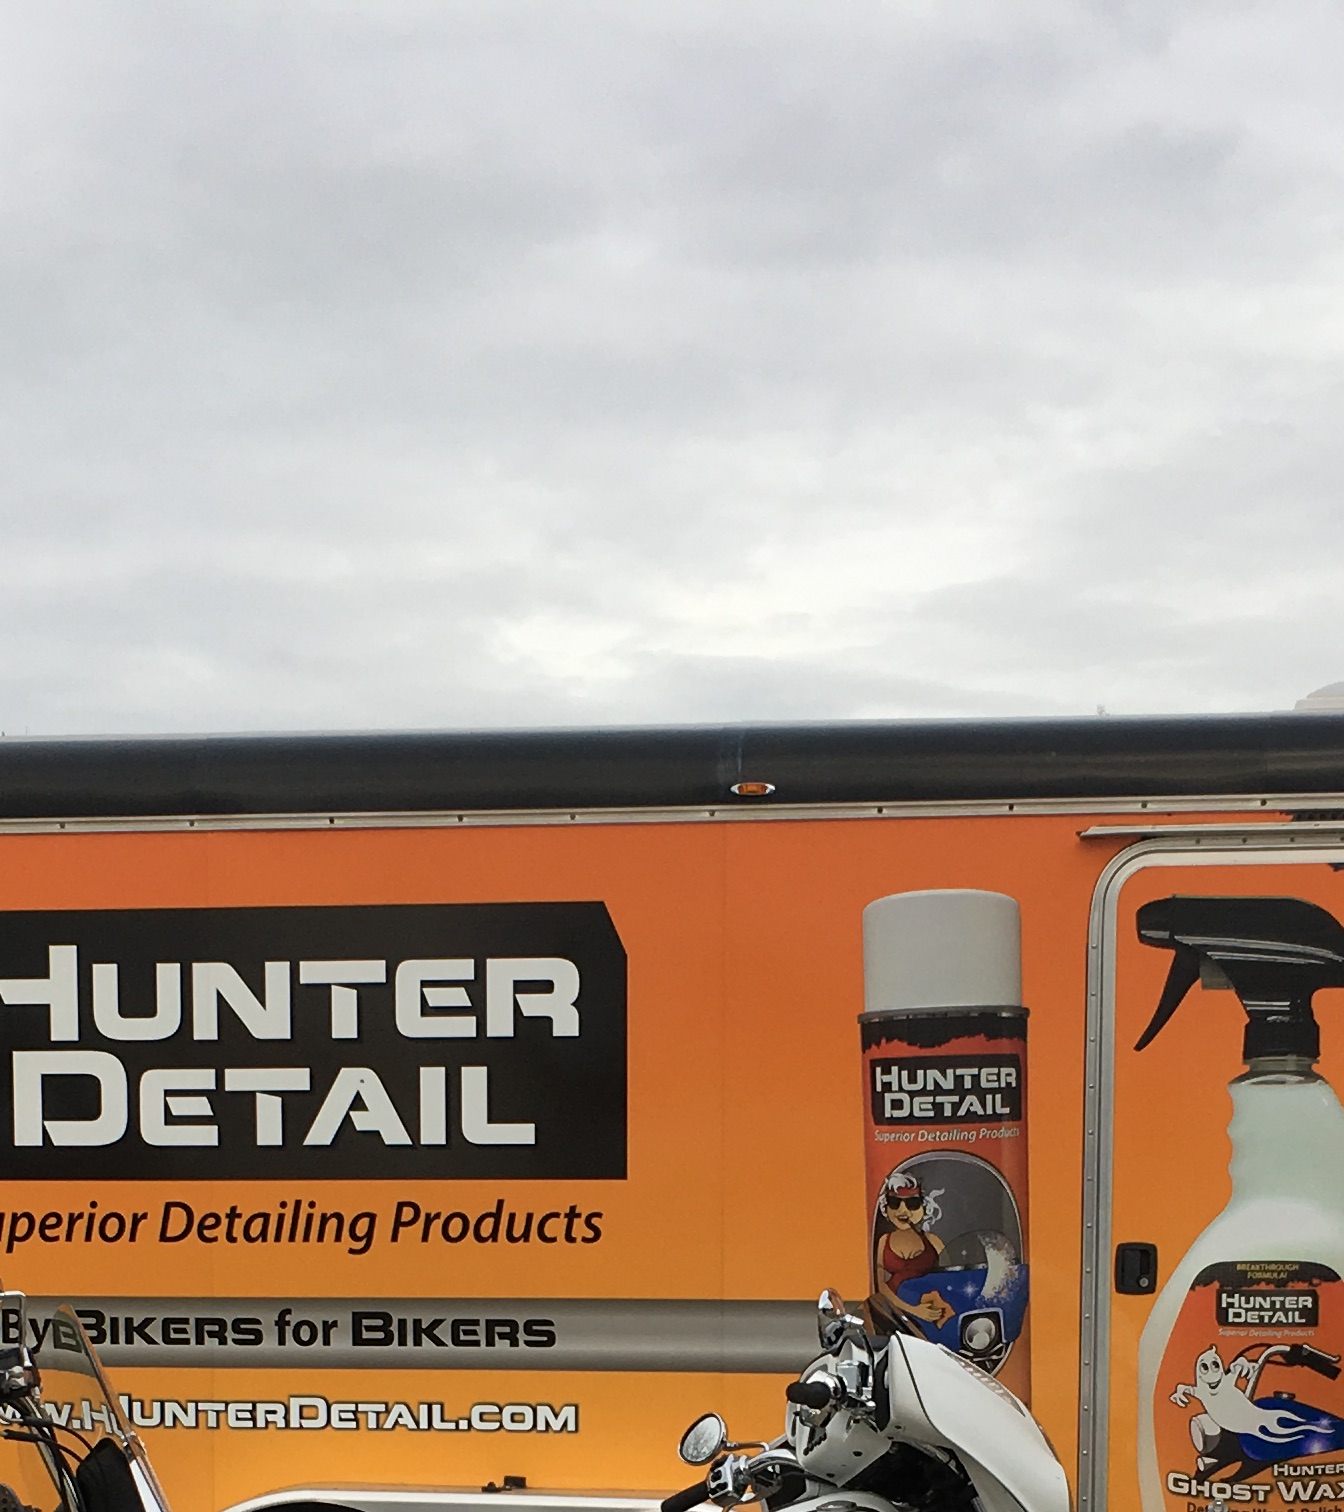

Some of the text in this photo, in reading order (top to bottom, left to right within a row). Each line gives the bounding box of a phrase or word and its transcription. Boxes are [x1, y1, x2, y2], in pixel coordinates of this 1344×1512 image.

[875, 1065, 1017, 1092] HUNTER
[11, 1050, 536, 1147] DETAIL
[883, 1092, 1010, 1118] DETAIL
[874, 1126, 1020, 1143] Superior Detailing Products
[158, 1198, 378, 1256] Detailing
[390, 1198, 604, 1244] Products
[1221, 1293, 1313, 1309] HUNTER
[1227, 1308, 1306, 1323] DETAIL
[1, 1308, 557, 1355] By BIKERS for BIKERS
[1167, 1472, 1271, 1501] GHOST
